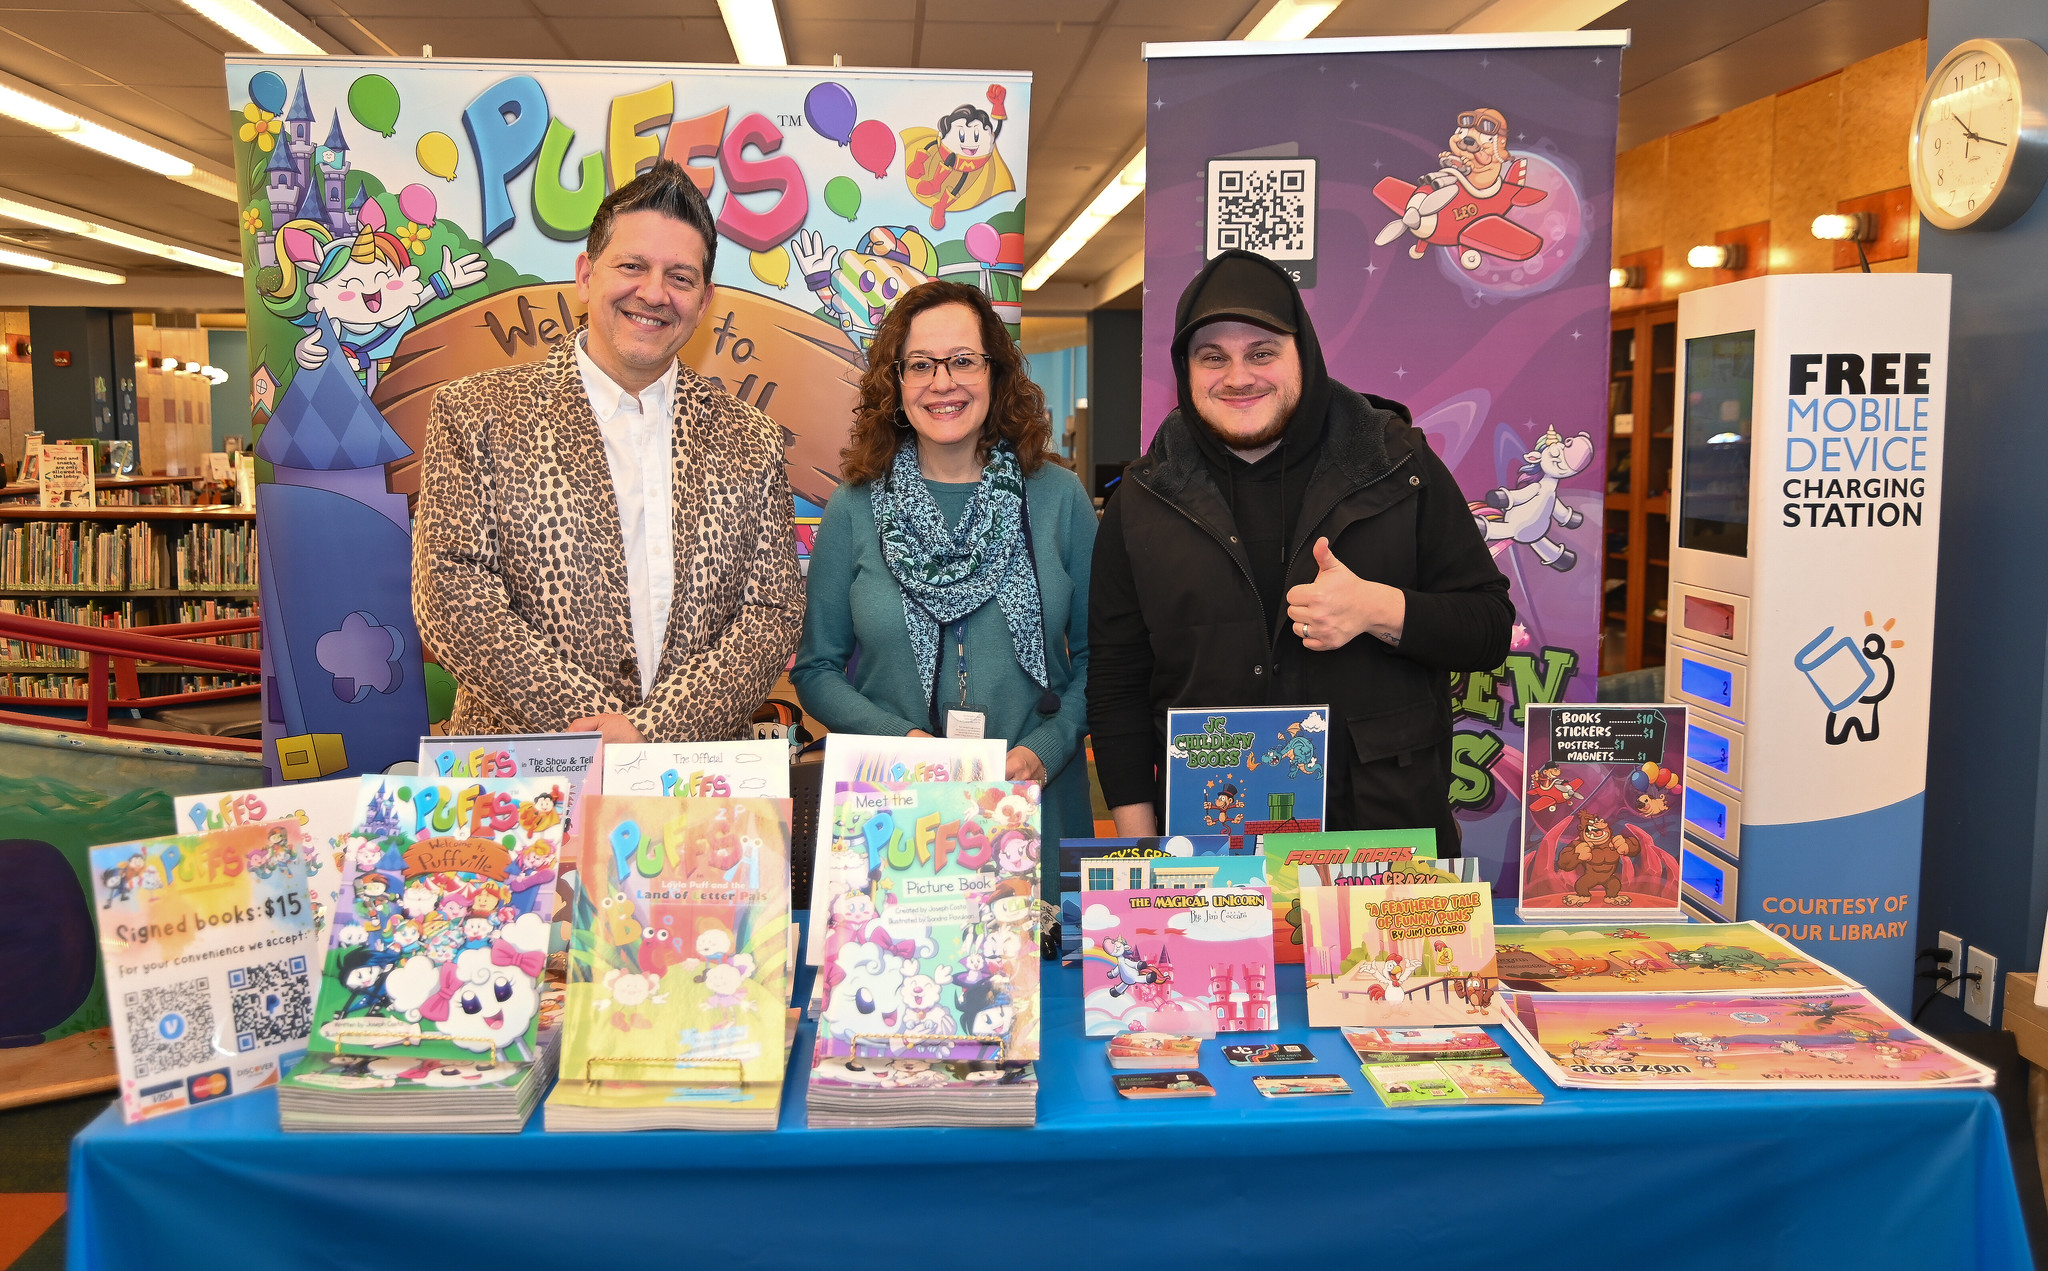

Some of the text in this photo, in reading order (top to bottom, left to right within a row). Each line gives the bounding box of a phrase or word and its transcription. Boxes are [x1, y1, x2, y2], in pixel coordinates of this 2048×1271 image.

[1975, 61, 1986, 81] 12
[462, 75, 808, 252] PUFFS
[1453, 203, 1479, 221] LEO
[714, 311, 755, 364] to
[1789, 353, 1931, 395] FREE
[1787, 398, 1929, 432] MOBILE
[1786, 436, 1927, 472] DEVICE
[1783, 478, 1925, 498] CHARGING
[1783, 502, 1922, 527] STATION
[1725, 616, 1730, 629] 1
[1722, 681, 1728, 695] 2
[1203, 716, 1226, 733] JC
[1562, 712, 1601, 724] BOOKS
[1555, 726, 1612, 737] STICKERS
[1174, 732, 1255, 751] CHILDREN
[435, 747, 518, 777] PUFFS
[529, 758, 547, 766] The
[548, 757, 567, 766] Show
[570, 757, 577, 765] &
[580, 756, 594, 764] Tell
[673, 752, 723, 763] The Official
[1186, 749, 1241, 768] BOOKS
[1720, 748, 1726, 762] 3
[535, 764, 587, 773] Rock Concert
[891, 761, 949, 782] PUFFS
[660, 768, 731, 797] PUFFS
[856, 794, 914, 808] Meet the
[189, 794, 267, 831] PUFFS
[413, 784, 519, 838] PUFFS
[1717, 814, 1723, 828] 4
[428, 837, 486, 852] Welcome to
[609, 814, 743, 885] PUFFS
[862, 811, 992, 875] PUFFS
[160, 844, 244, 886] PUFFS
[418, 850, 492, 873] Puffville
[1284, 849, 1349, 866] FROM
[662, 881, 686, 889] Layla
[731, 881, 745, 889] the
[907, 876, 991, 895] Picture Book
[1714, 879, 1721, 893] 5
[637, 890, 767, 901] Land of Letter Pals
[1130, 895, 1264, 909] THE MAGICAL UNICORN
[1380, 898, 1448, 915] FEATHERED
[1449, 892, 1480, 907] TALE
[1762, 894, 1908, 915] COURTESY OF
[1204, 910, 1218, 923] Jim
[1221, 910, 1247, 922] Coccaro
[1376, 916, 1393, 930] OF
[1394, 912, 1435, 928] FUNNY
[117, 914, 187, 944] Signed
[1391, 924, 1465, 940] BY JIM COCCARO
[1829, 921, 1908, 941] LIBRARY
[119, 965, 137, 978] For
[144, 959, 169, 974] your
[174, 945, 245, 966] convenience
[250, 941, 263, 951] we
[237, 1062, 274, 1077] DISCOVER
[1571, 1064, 1691, 1075] amazon
[153, 1091, 174, 1103] VISA
